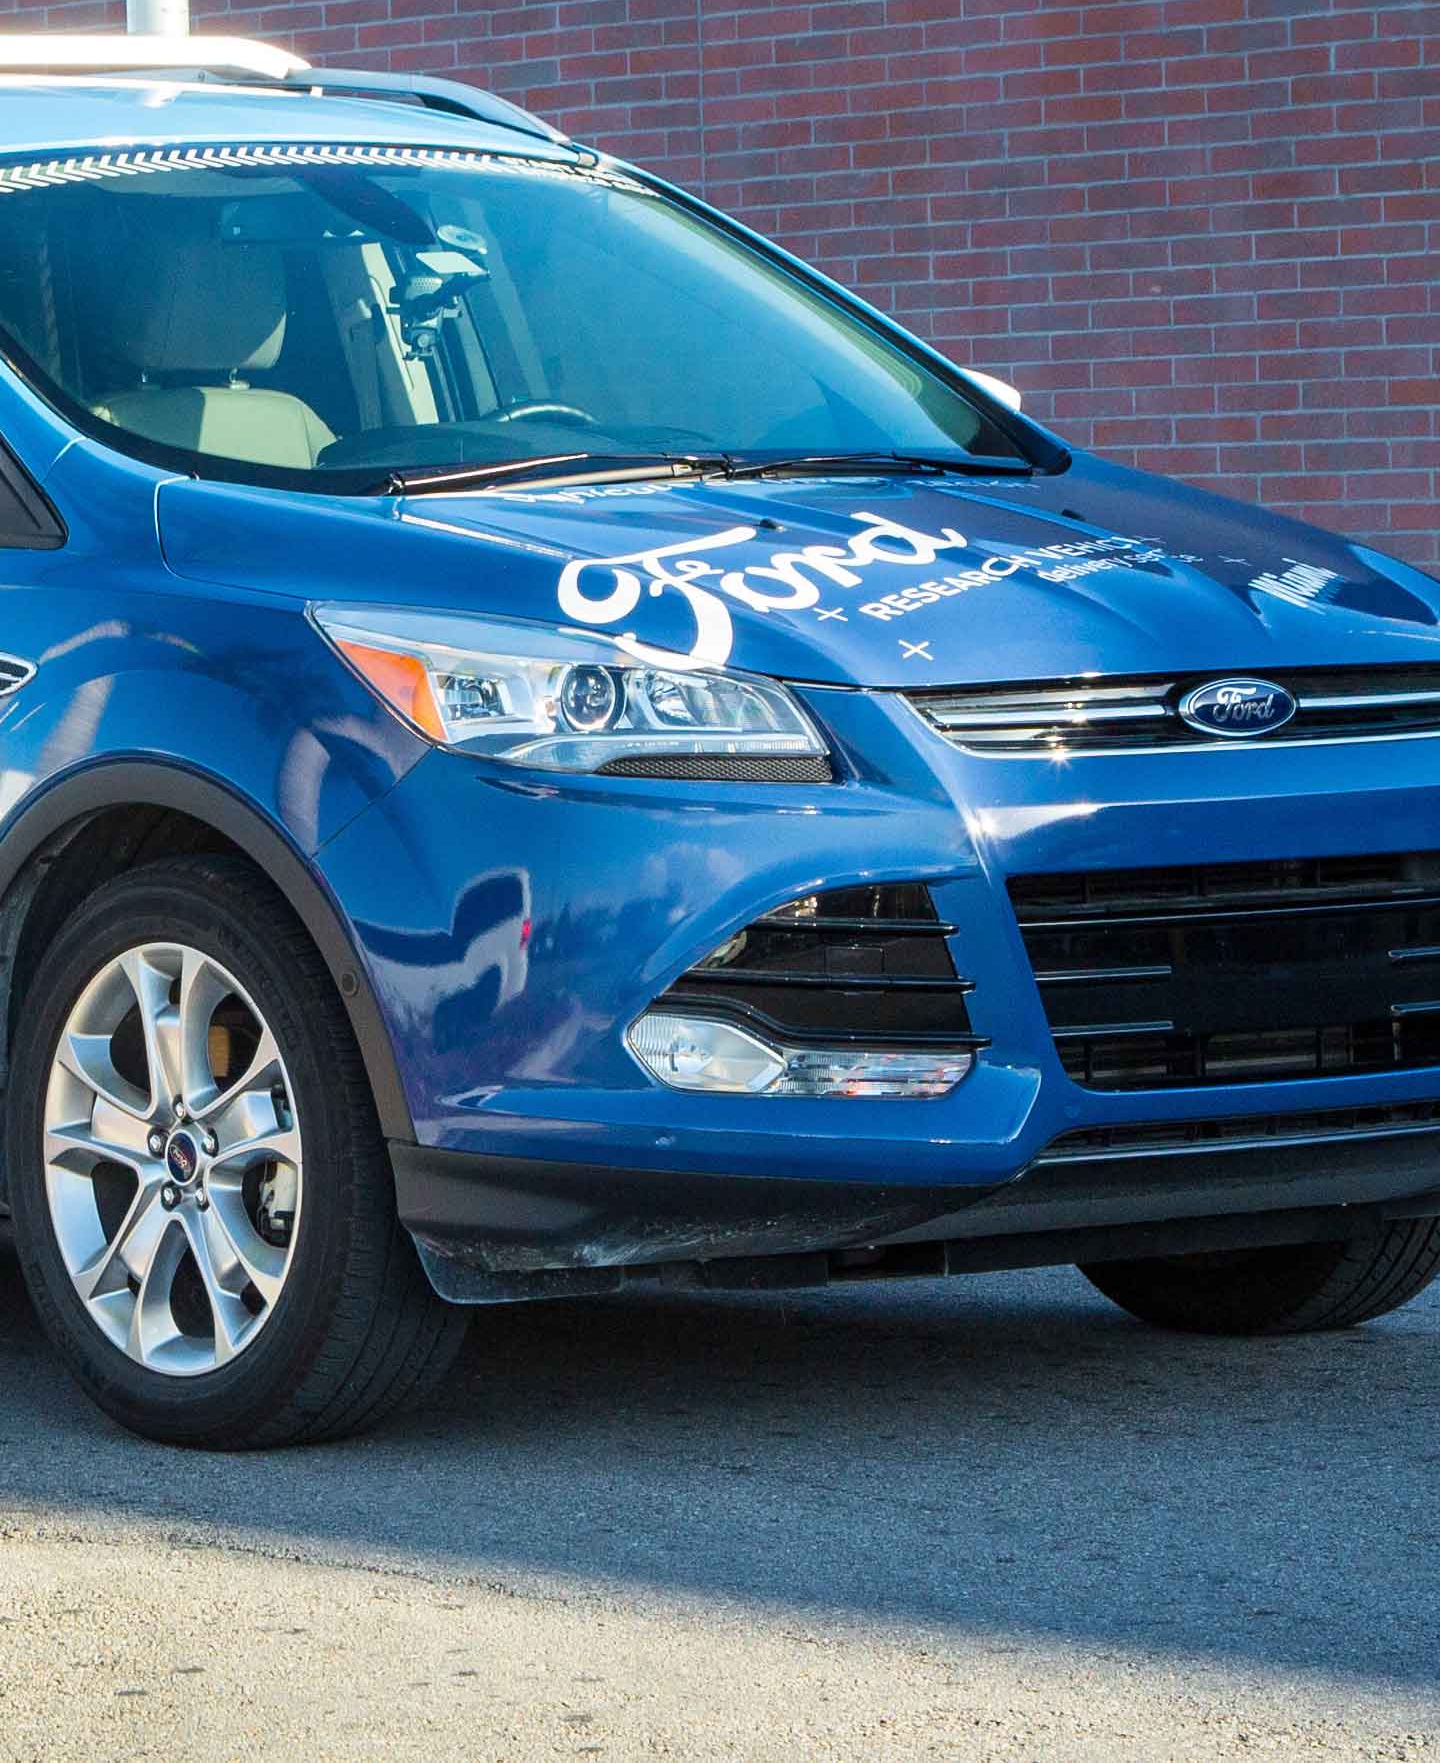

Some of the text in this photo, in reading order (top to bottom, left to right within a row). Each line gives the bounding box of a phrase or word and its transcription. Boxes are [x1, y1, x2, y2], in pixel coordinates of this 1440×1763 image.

[557, 511, 968, 672] Ford
[858, 554, 1041, 622] RESEARCH
[1037, 557, 1133, 583] delivery
[1213, 687, 1275, 722] Ford
